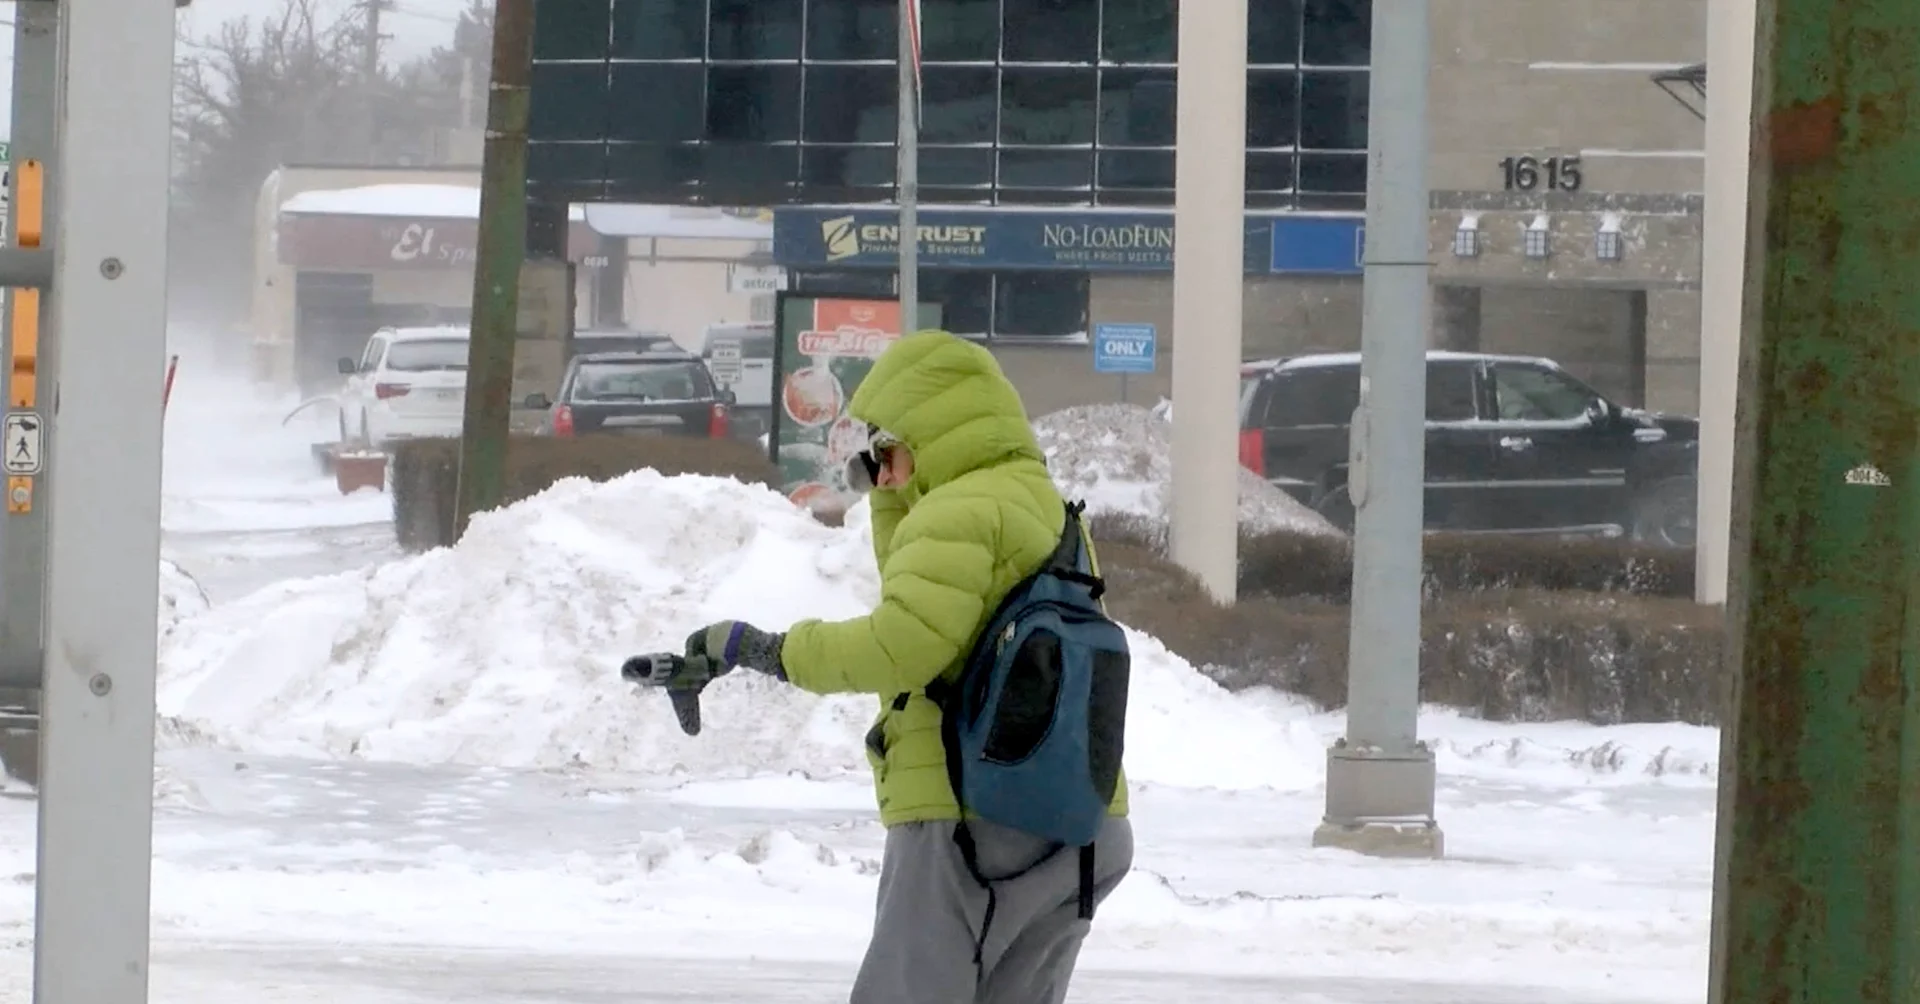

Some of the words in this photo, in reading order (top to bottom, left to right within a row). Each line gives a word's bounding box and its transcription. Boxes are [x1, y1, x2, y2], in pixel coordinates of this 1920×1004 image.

[1499, 157, 1581, 191] 1615
[861, 225, 985, 242] ENRUST
[1105, 340, 1147, 356] ONLY
